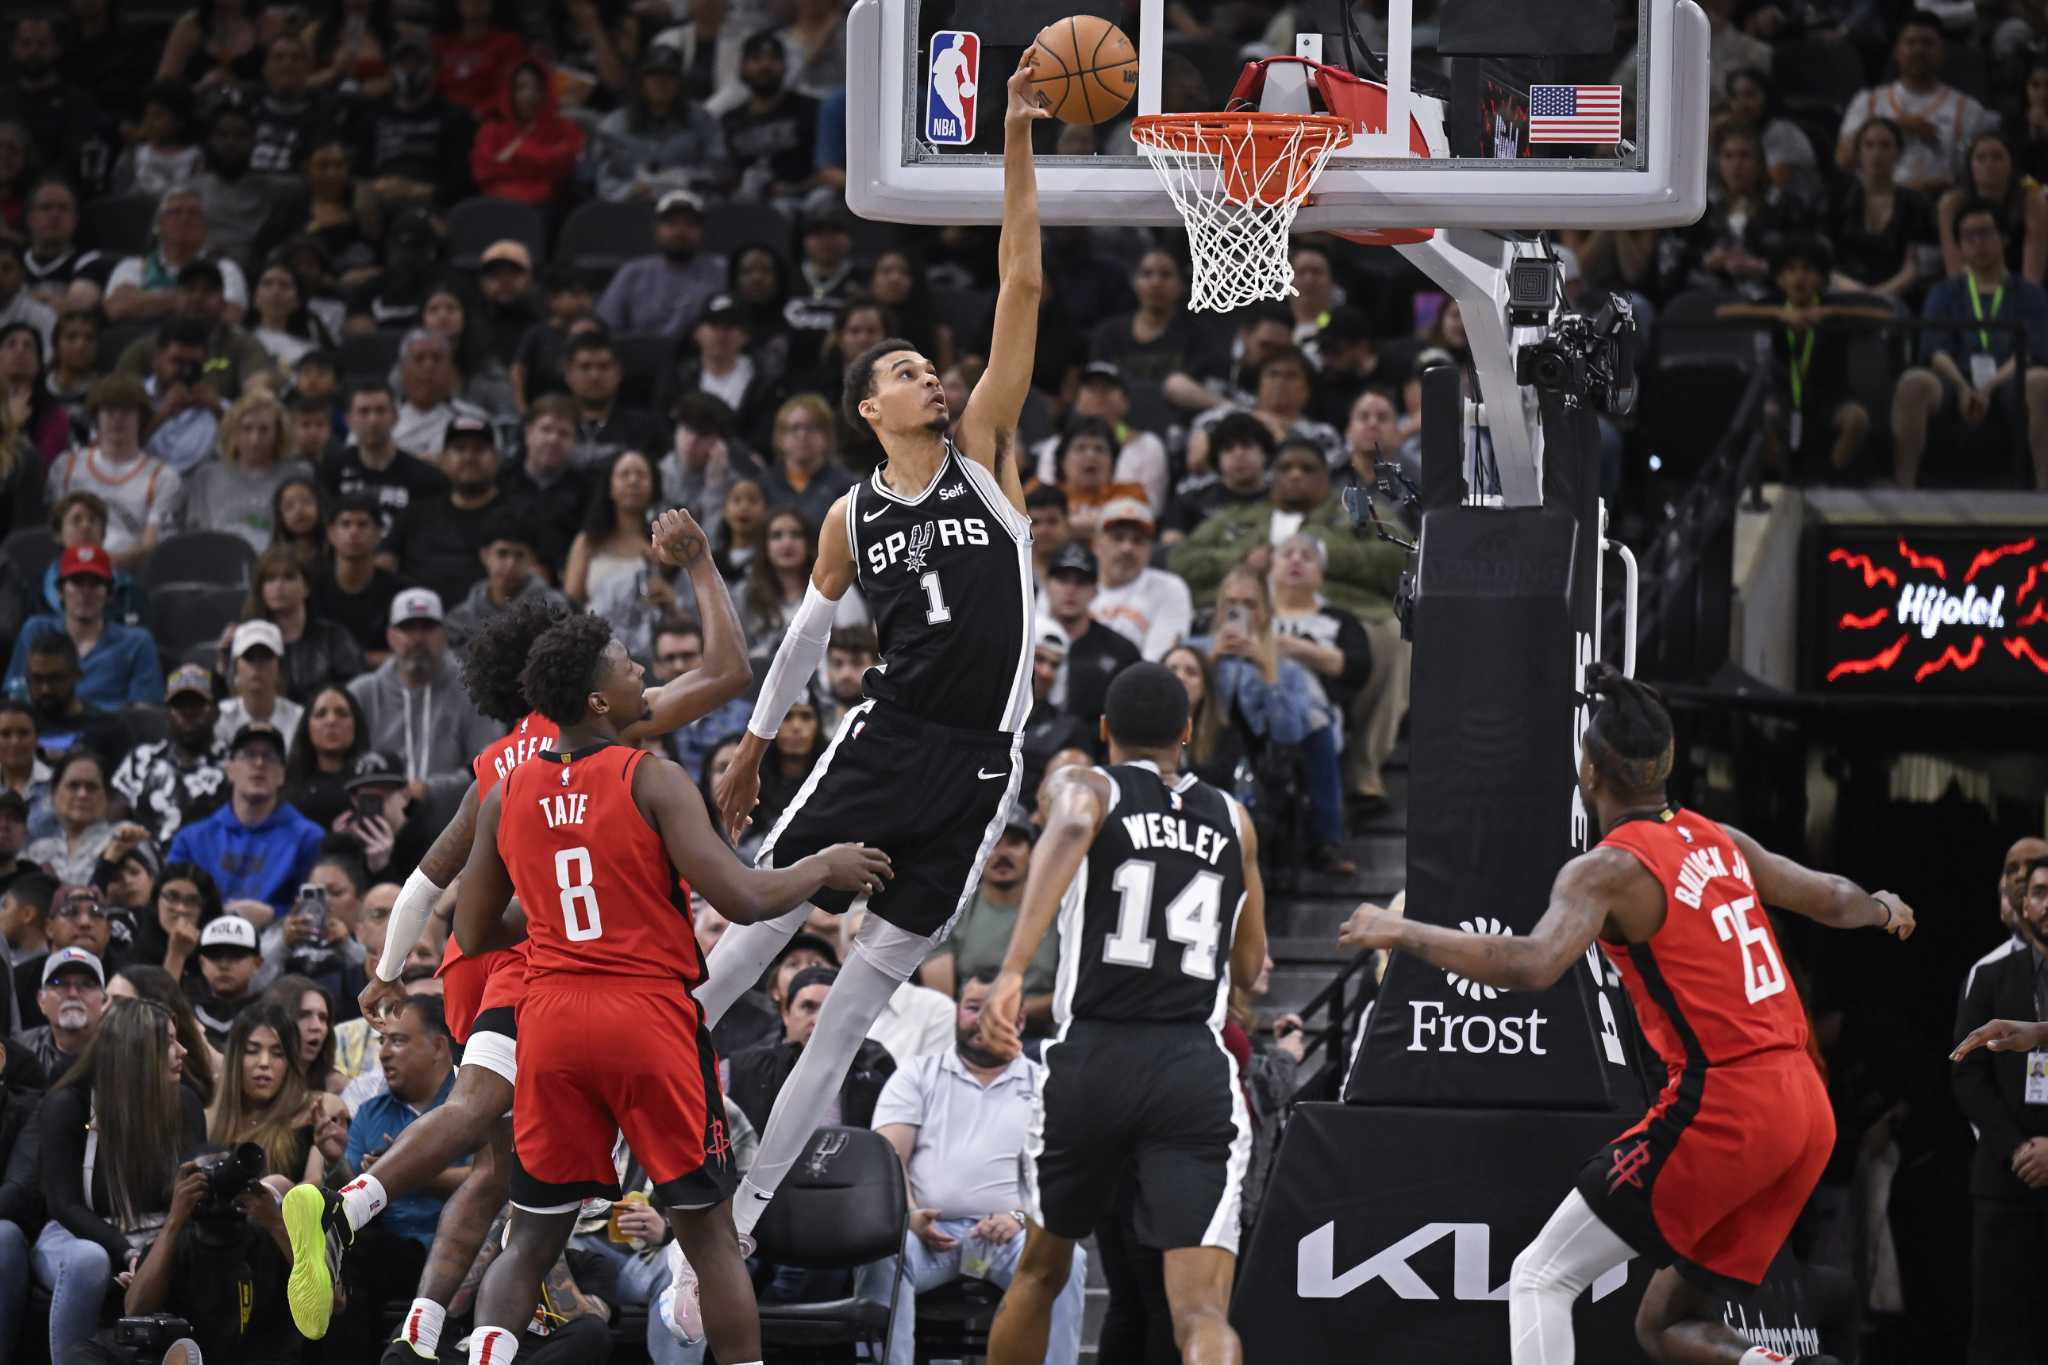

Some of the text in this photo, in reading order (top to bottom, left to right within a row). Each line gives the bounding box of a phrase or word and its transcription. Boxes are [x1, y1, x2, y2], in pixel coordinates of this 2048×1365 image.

[933, 118, 957, 137] NBA
[938, 483, 967, 501] Self.
[867, 518, 989, 574] SPURS
[919, 570, 952, 626] 1
[494, 736, 553, 780] GREEN
[538, 793, 589, 829] TATE
[1121, 812, 1229, 866] WESLEY
[554, 846, 603, 942] 8
[1102, 858, 1225, 981] 14
[1711, 896, 1786, 1005] 25
[1407, 1001, 1548, 1055] Frost
[1297, 1220, 1629, 1303] KI
